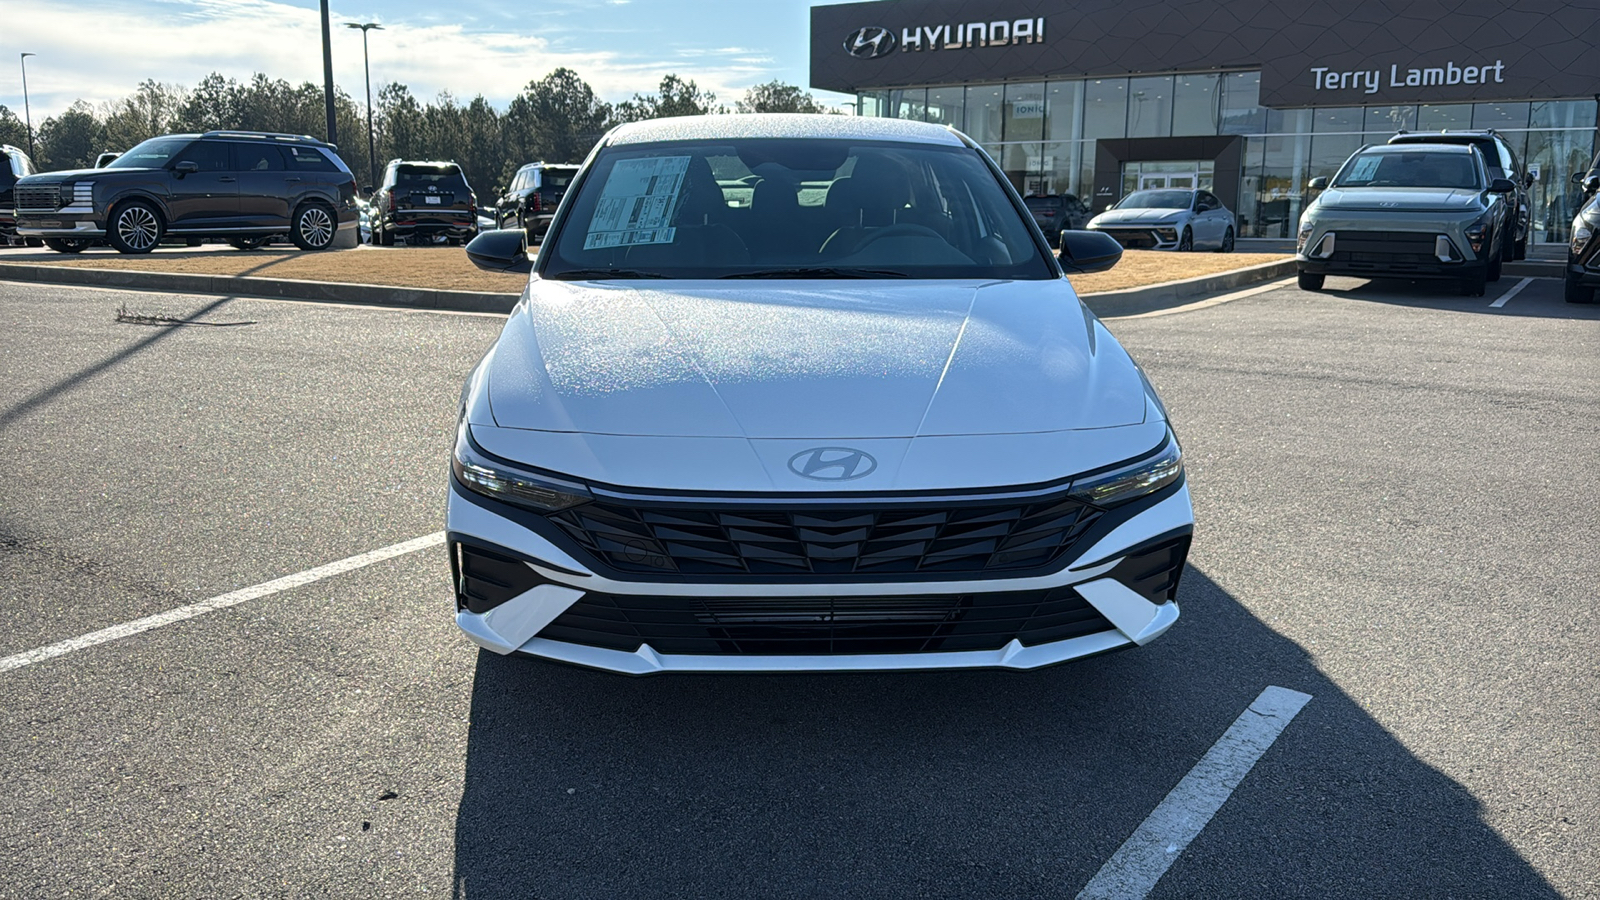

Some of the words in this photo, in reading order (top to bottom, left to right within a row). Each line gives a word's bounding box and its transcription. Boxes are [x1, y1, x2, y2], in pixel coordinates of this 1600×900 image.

[902, 17, 1044, 52] HYUNDAI
[1310, 67, 1380, 94] Terry
[1390, 60, 1505, 87] Lambert
